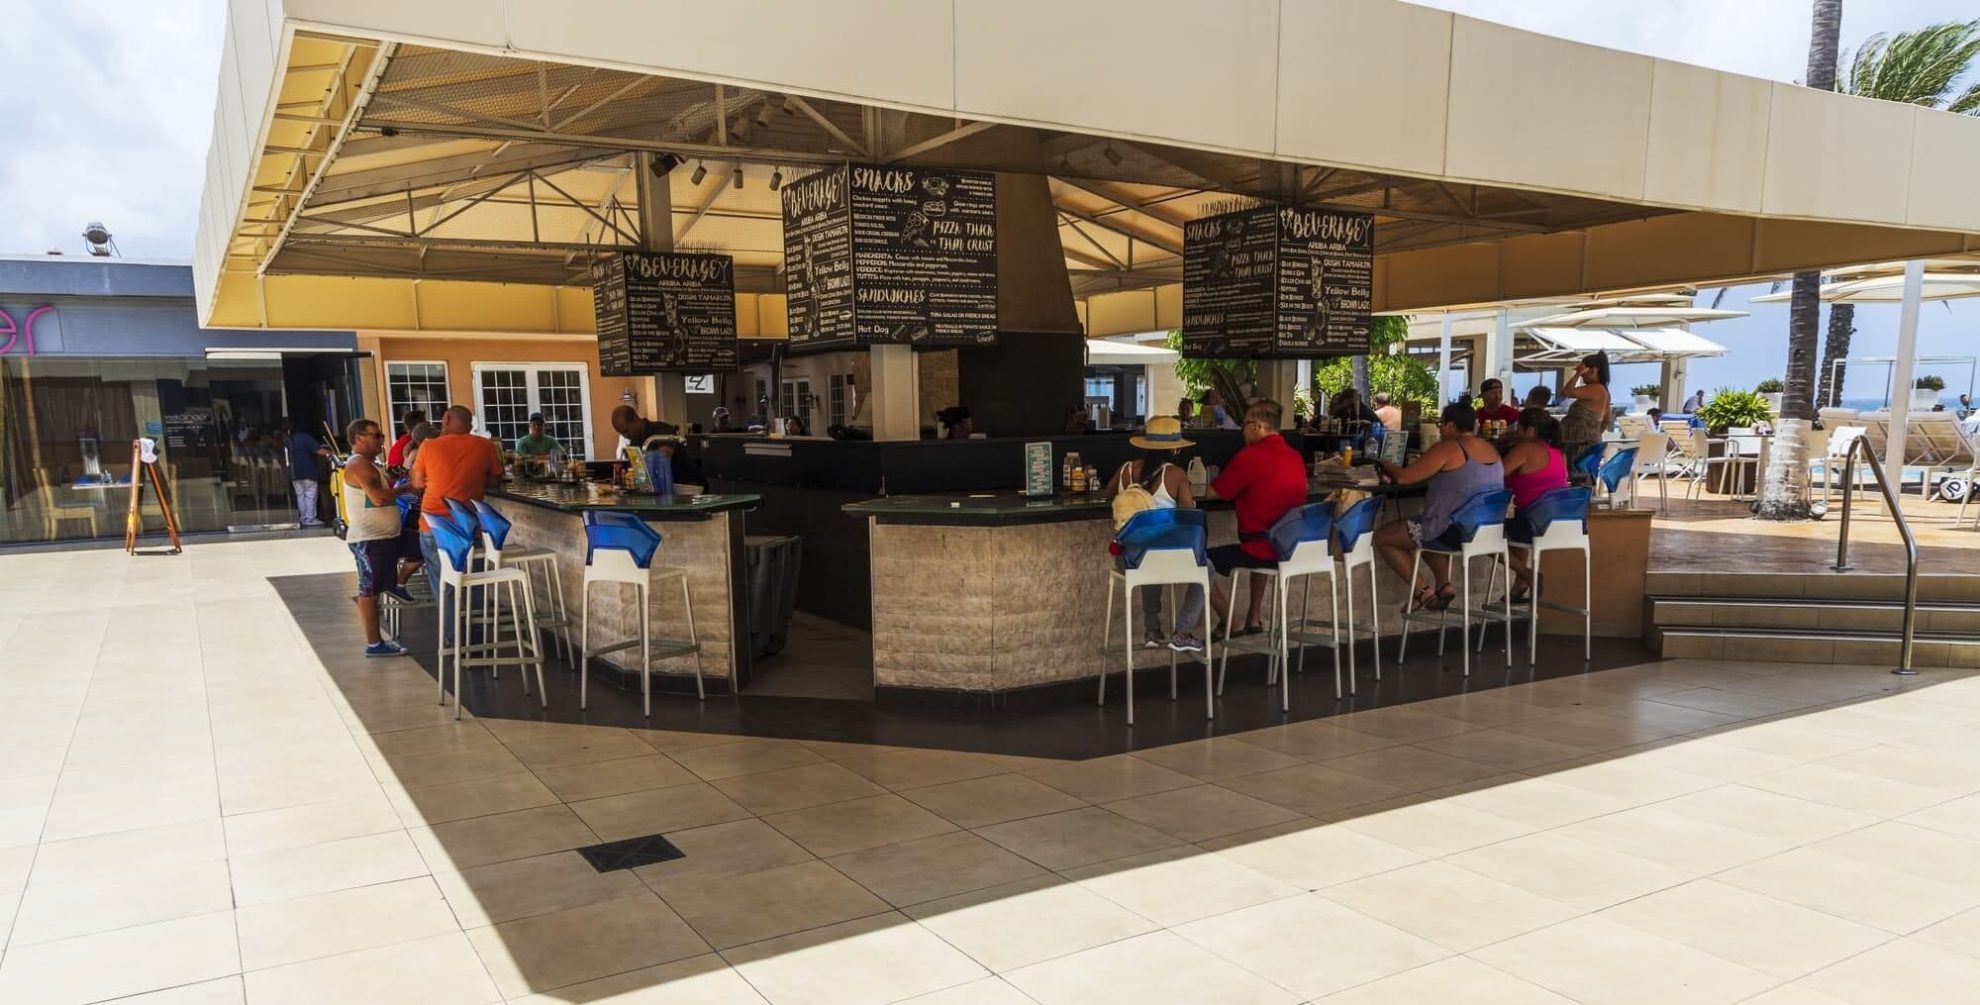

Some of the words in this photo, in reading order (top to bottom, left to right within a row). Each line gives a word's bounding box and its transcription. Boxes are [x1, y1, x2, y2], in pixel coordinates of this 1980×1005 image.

[852, 168, 915, 193] SNACKS
[933, 221, 960, 236] PIZZA
[1293, 211, 1364, 244] BEVERAGE
[967, 240, 994, 252] CRUST
[640, 256, 720, 281] BEVERAGE
[857, 288, 925, 304] SANDWICHES
[1325, 286, 1350, 295] Yellow
[1351, 287, 1370, 297] Belly
[682, 316, 709, 324] Yellow
[712, 316, 732, 325] Belly
[858, 325, 871, 333] Hot
[874, 325, 889, 334] Dog
